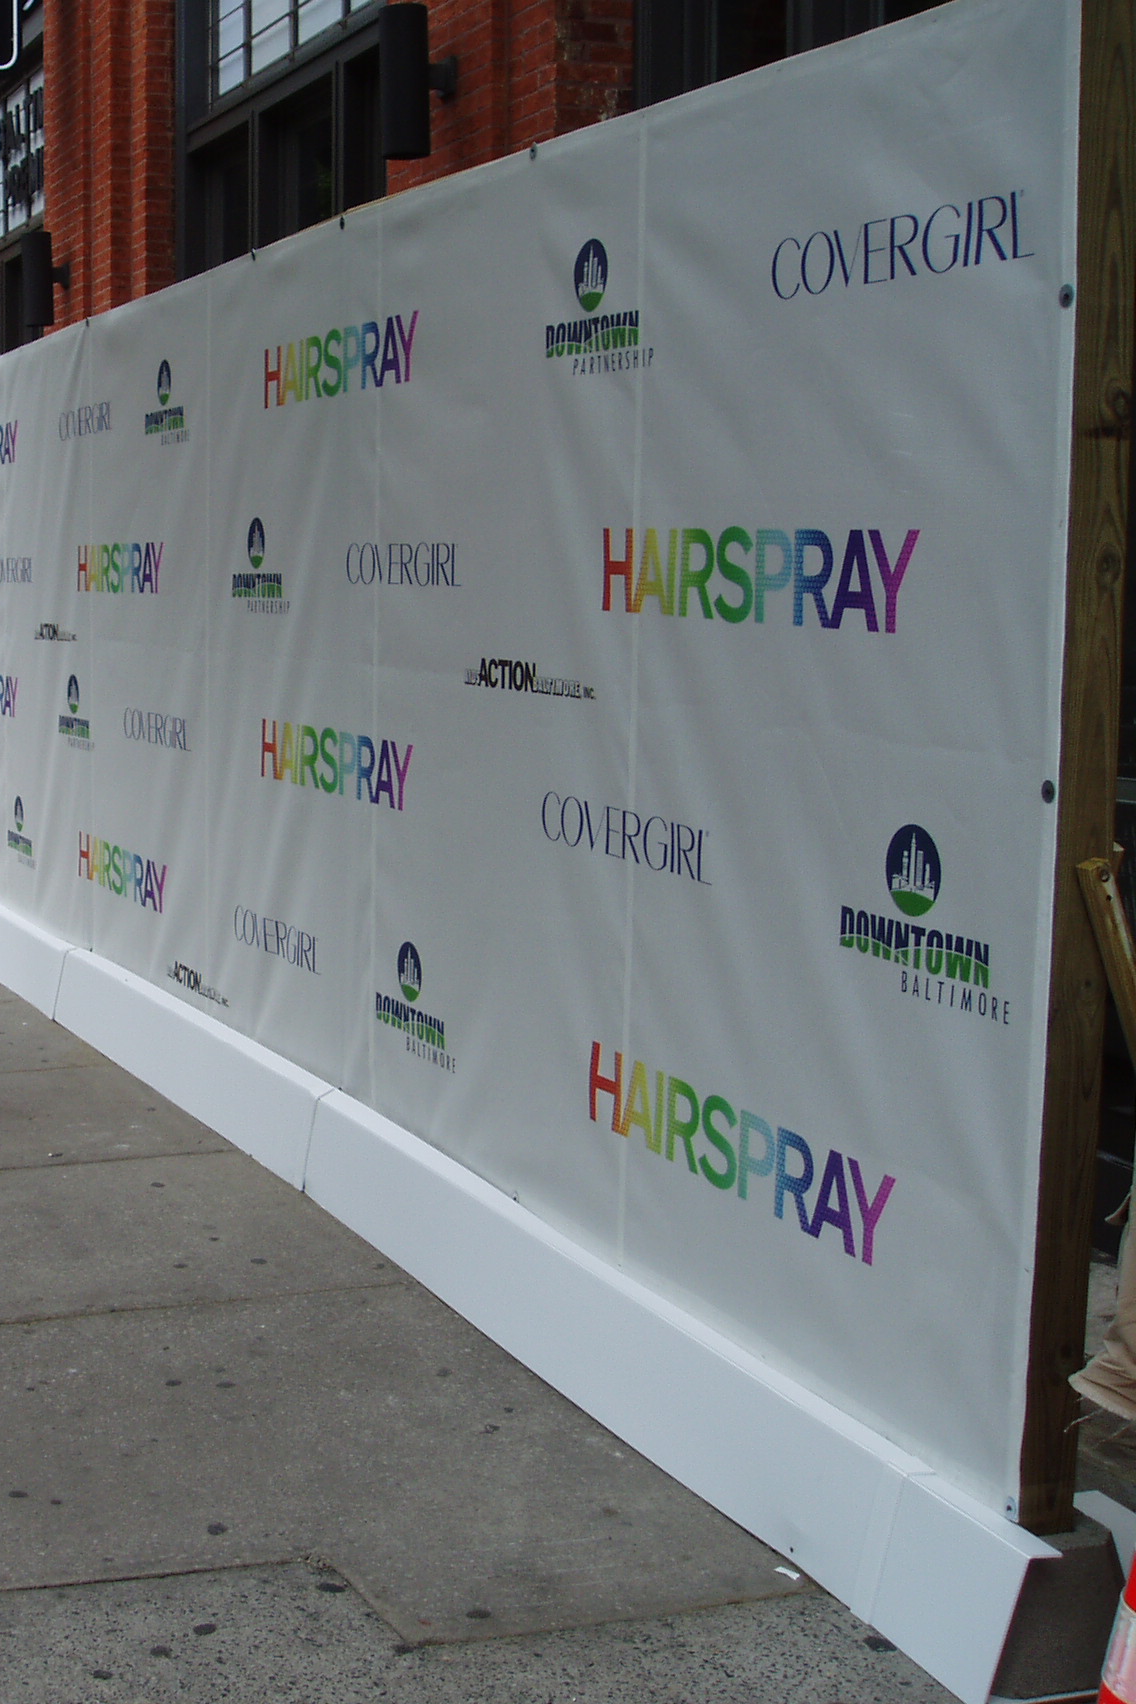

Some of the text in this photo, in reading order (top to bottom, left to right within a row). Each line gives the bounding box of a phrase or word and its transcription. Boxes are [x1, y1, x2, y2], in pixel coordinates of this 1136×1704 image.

[772, 190, 1034, 300] COVERGIRL
[264, 310, 419, 409] HAIRSPRAY
[546, 310, 639, 359] DOWNTOWN
[572, 347, 654, 375] PARTNERSHIP
[78, 542, 165, 593] HAIRSPRAY
[232, 573, 282, 598] DOWNTOWN
[346, 543, 461, 586] COVERGIRL
[602, 526, 920, 634] HAIRSPRAY
[478, 658, 536, 691] ACTION
[123, 708, 191, 752] COVERGIRL
[261, 719, 414, 811] HAIRSPRAY
[542, 792, 711, 885] COVERGIRL
[79, 832, 168, 913] HAIRSPRAY
[235, 906, 320, 975] COVERGIRL
[840, 905, 990, 989] DOWNTOWN
[376, 992, 445, 1050] DOWNTOWN
[901, 971, 1010, 1025] BALTIMORE
[406, 1036, 455, 1074] BALTIMORE
[589, 1041, 896, 1266] HAIRSPRAY
